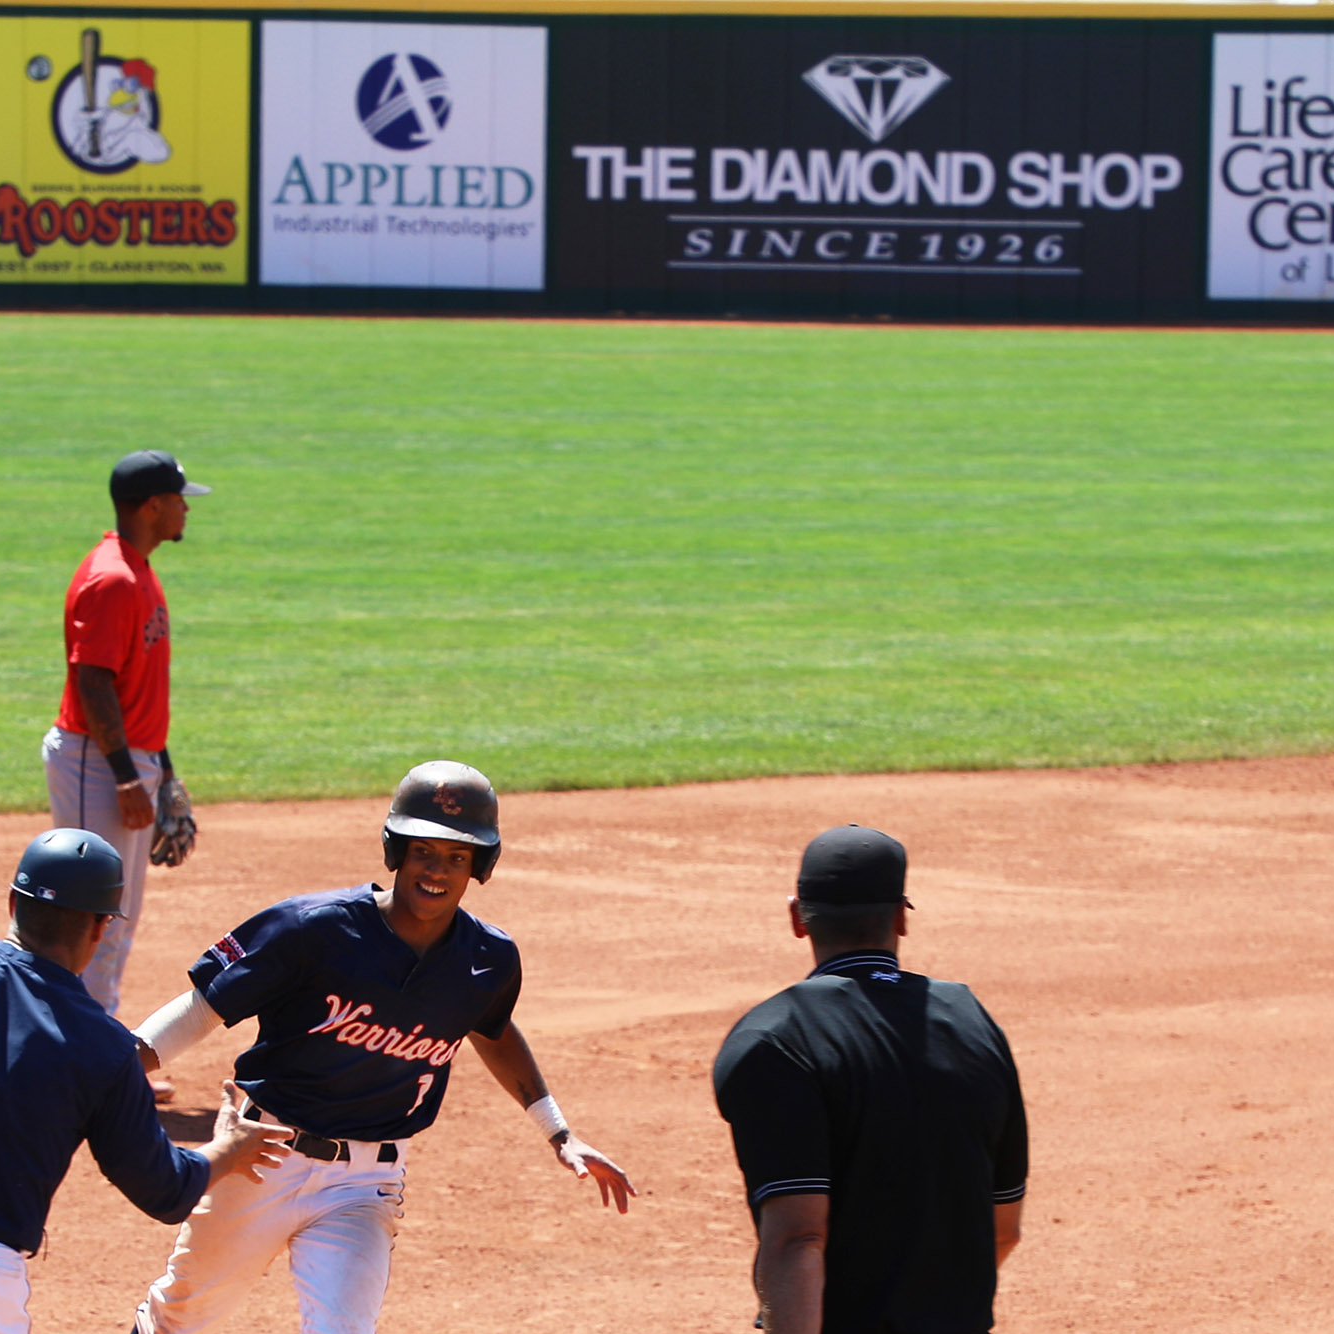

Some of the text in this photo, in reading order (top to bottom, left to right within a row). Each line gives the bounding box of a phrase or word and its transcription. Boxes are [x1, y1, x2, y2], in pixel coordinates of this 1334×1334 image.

[271, 155, 534, 210] APPLIED
[572, 145, 1183, 210] THE DIAMOND SHOP
[273, 215, 530, 241] Industrial Technologies
[684, 228, 1064, 264] SINCE 1926
[1280, 257, 1309, 283] of
[307, 994, 462, 1067] Warriors
